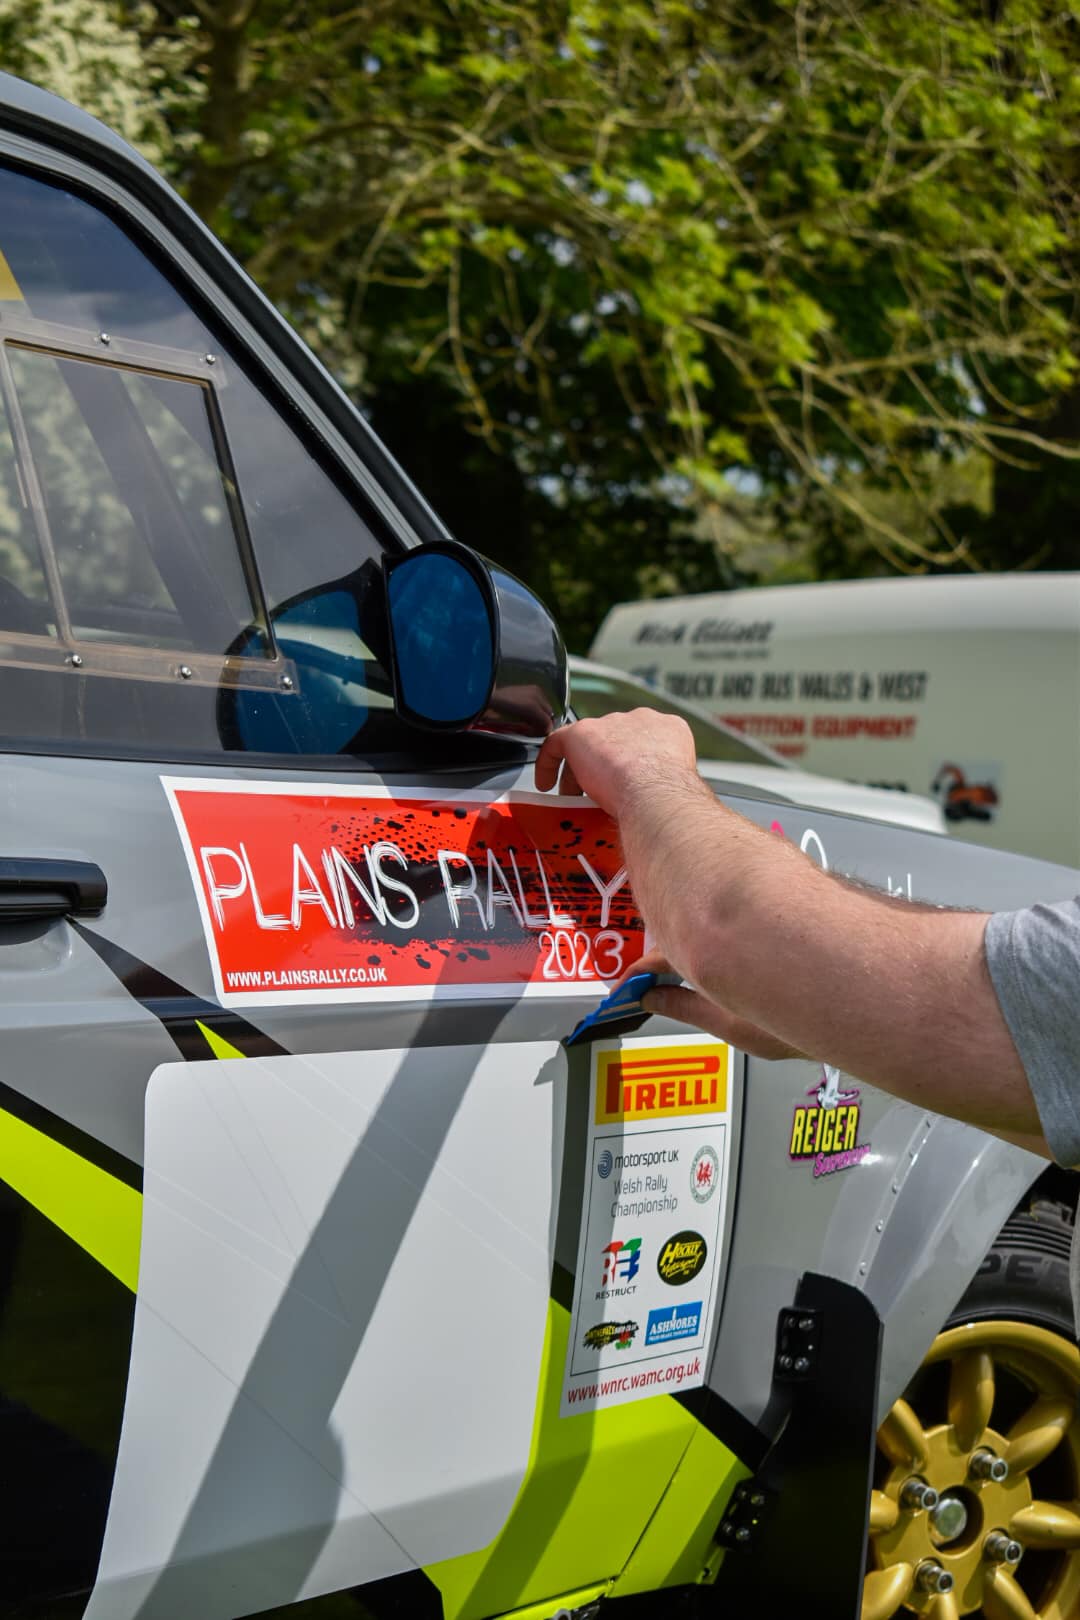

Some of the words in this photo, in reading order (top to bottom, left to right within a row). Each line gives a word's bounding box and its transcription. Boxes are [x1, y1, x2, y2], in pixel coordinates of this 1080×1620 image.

[667, 672, 715, 699] TRUCK
[720, 672, 754, 698] AND
[760, 672, 793, 698] BUS
[878, 671, 929, 699] WEST
[811, 715, 917, 739] EQUIPMENT
[200, 841, 420, 931] PLAINS
[437, 847, 629, 930] RALLY
[539, 929, 624, 979] 2023
[227, 966, 388, 988] WWW.PLAINSRALLY.CO.UK
[606, 1055, 720, 1114] PIRELLI
[790, 1105, 858, 1155] REIGER
[614, 1151, 666, 1169] motorsport
[614, 1178, 643, 1195] Welsh
[645, 1175, 668, 1193] Rally
[610, 1193, 678, 1218] Championship
[595, 1286, 636, 1300] RESTRUCT
[649, 1315, 698, 1334] ASHMORES
[568, 1356, 700, 1404] www.wnrc.wamc.org.uk
